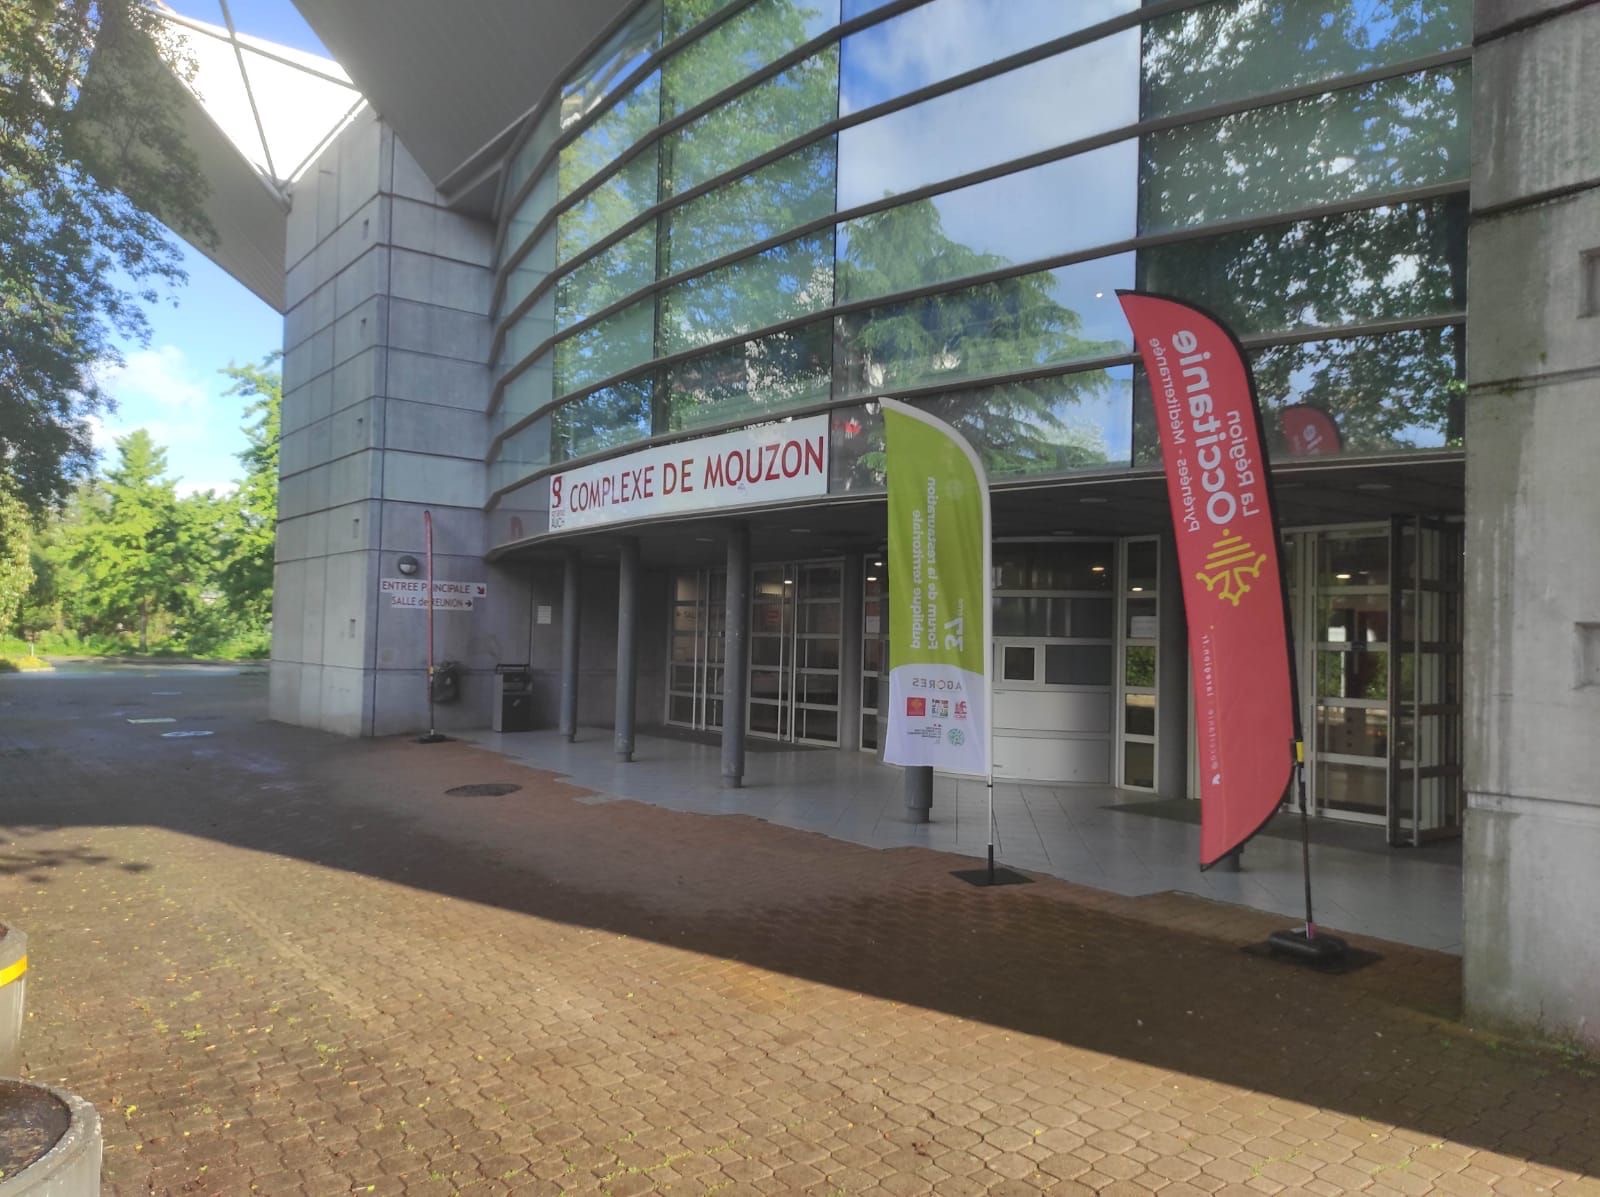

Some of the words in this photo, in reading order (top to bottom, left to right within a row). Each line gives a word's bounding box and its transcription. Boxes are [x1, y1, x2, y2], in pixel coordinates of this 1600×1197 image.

[570, 466, 655, 512] COMPLEXE
[662, 458, 695, 496] DE
[703, 435, 825, 491] MOUZON
[382, 581, 419, 592] ENTREE
[392, 596, 416, 606] SALLE
